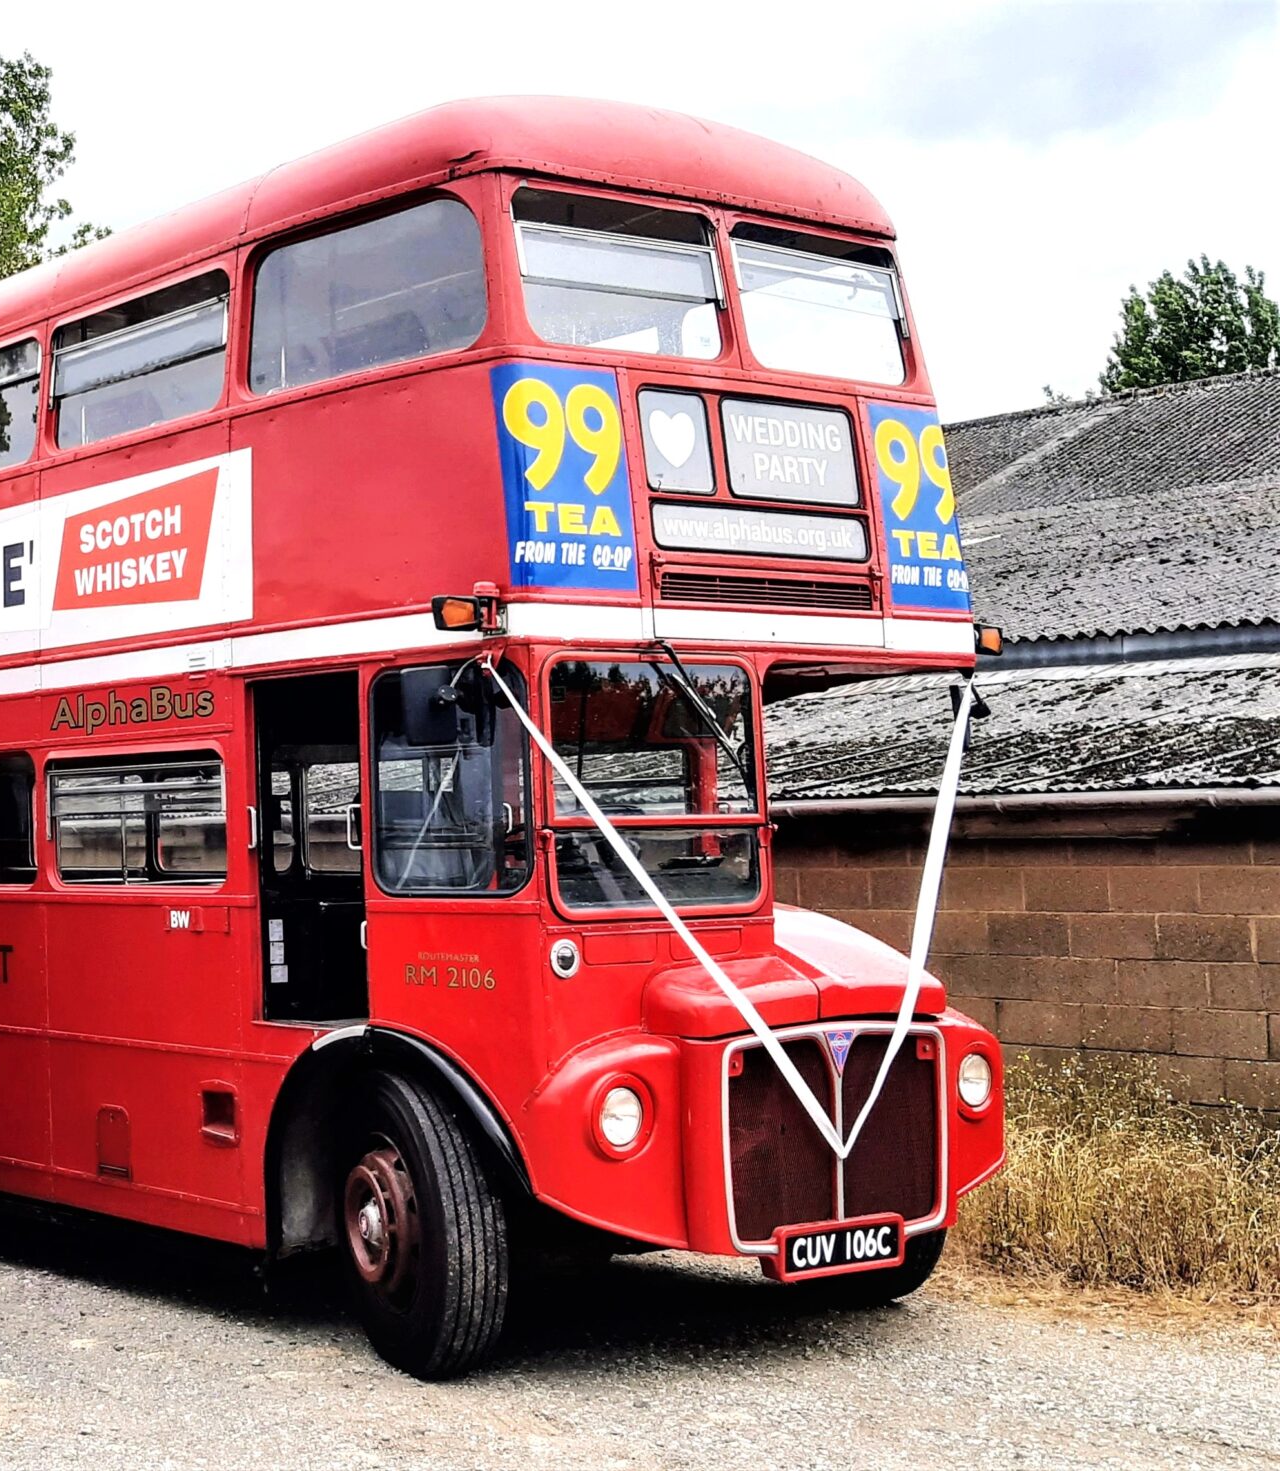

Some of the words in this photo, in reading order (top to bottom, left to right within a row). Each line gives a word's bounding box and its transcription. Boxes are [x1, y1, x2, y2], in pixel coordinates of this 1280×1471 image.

[503, 378, 621, 495] 99
[730, 414, 842, 452] WEDDING
[753, 452, 827, 486] PARTY
[80, 504, 182, 554] SCOTCH
[524, 501, 622, 537] TEA
[663, 516, 853, 551] www.alphabus.org.uk
[514, 540, 556, 564] FROM
[561, 542, 586, 566] THE
[592, 545, 632, 567] CO-OP
[891, 530, 963, 562] TEA
[74, 548, 188, 597] WHISKEY
[891, 564, 920, 586] FROM
[923, 565, 942, 587] THE
[946, 568, 970, 590] CO-O
[50, 685, 215, 736] AlphaBus
[170, 910, 191, 929] BW
[405, 964, 438, 986] RM
[447, 966, 496, 990] 2106
[792, 1233, 837, 1268] CUV
[845, 1226, 892, 1261] 106C
